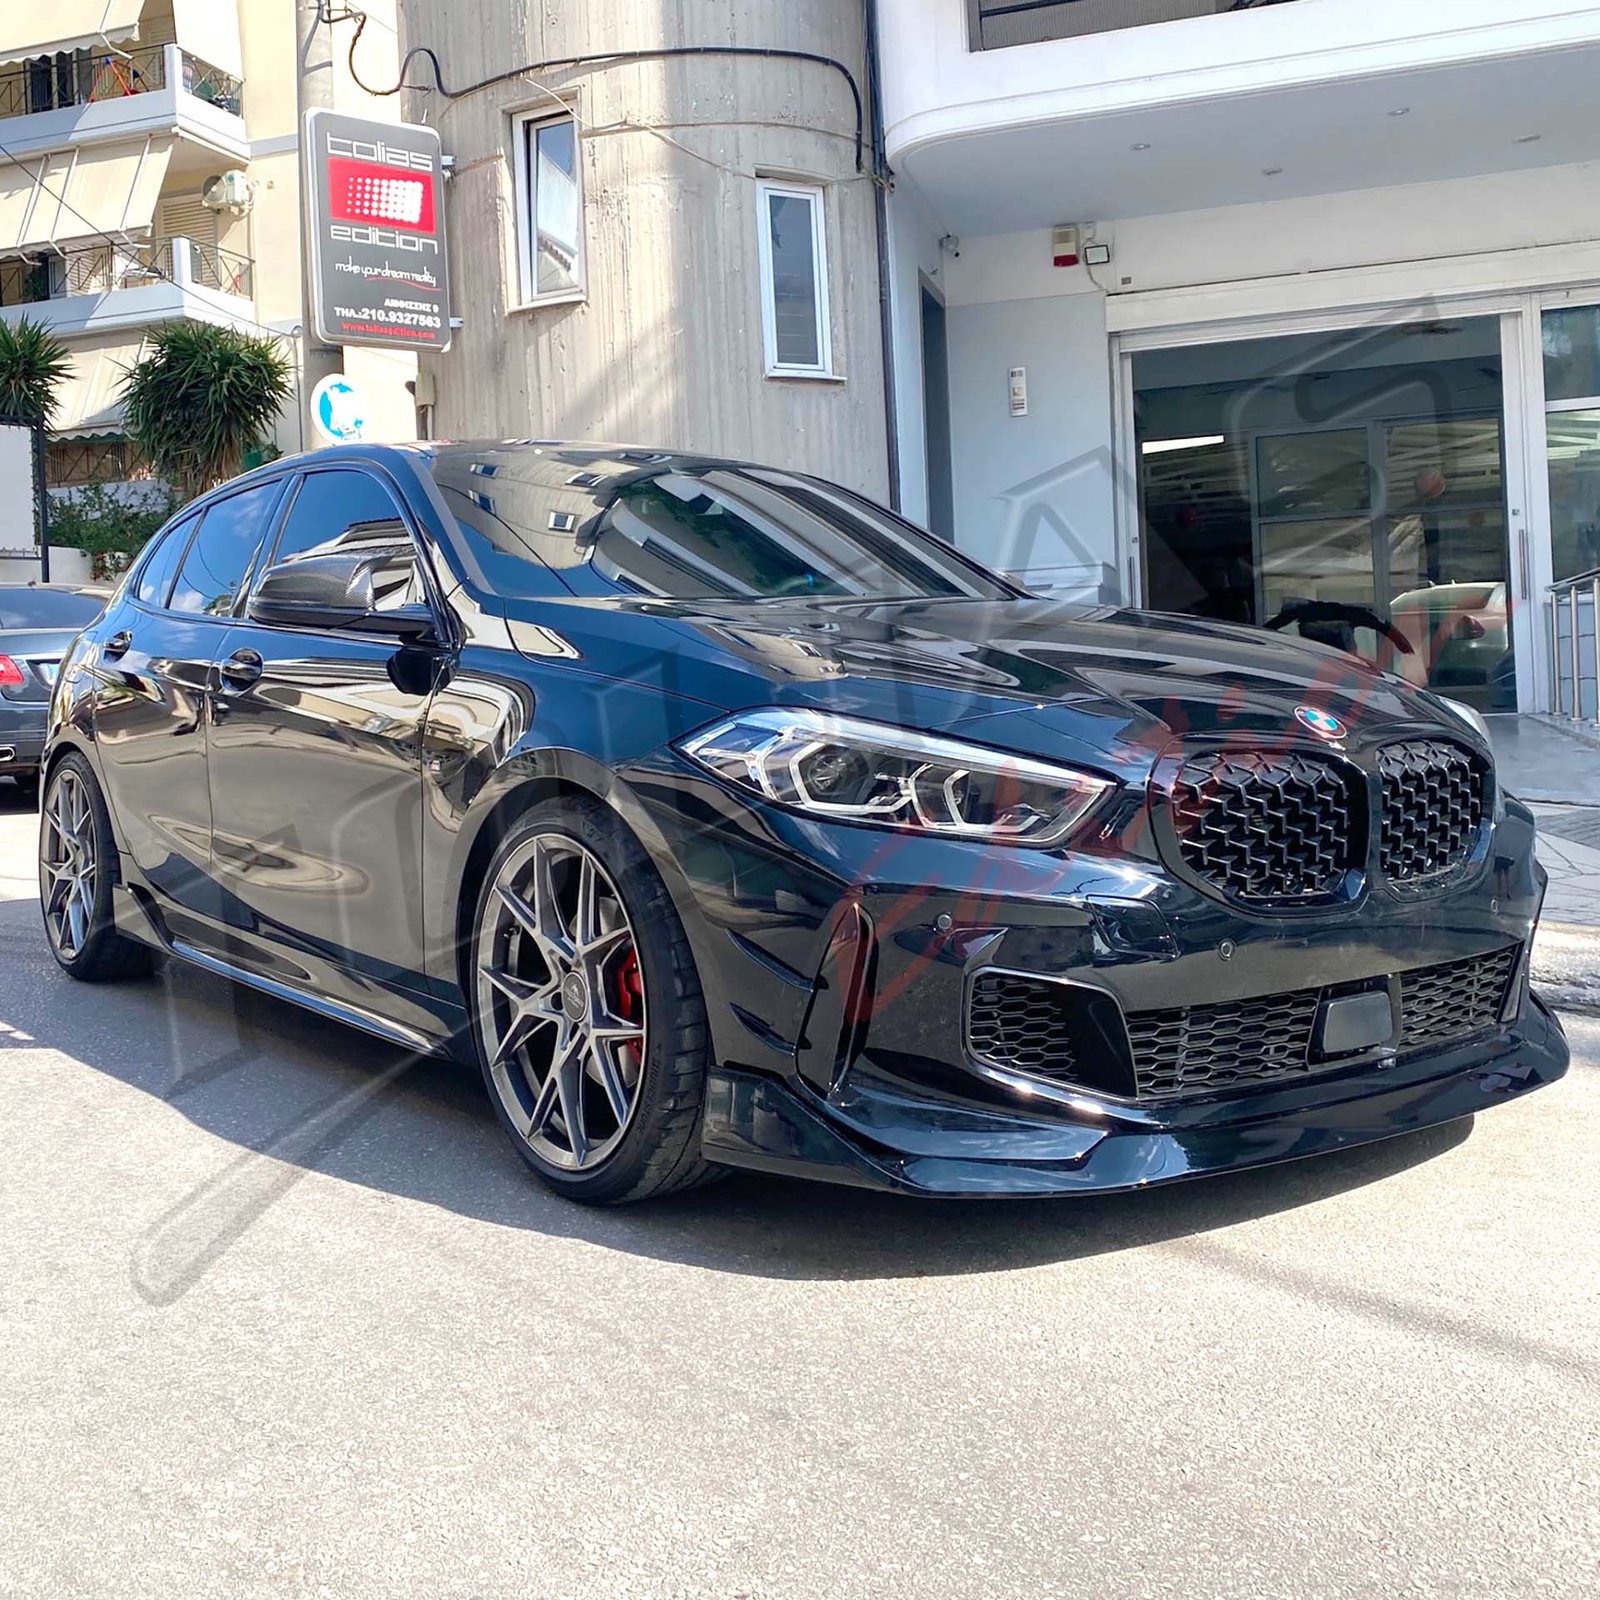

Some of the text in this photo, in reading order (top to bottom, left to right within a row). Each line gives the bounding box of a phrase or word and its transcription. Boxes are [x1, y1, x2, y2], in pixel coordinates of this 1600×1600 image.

[326, 132, 433, 172] tolias
[330, 225, 438, 254] edition
[335, 256, 436, 287] make your dream reality
[432, 304, 439, 313] 9
